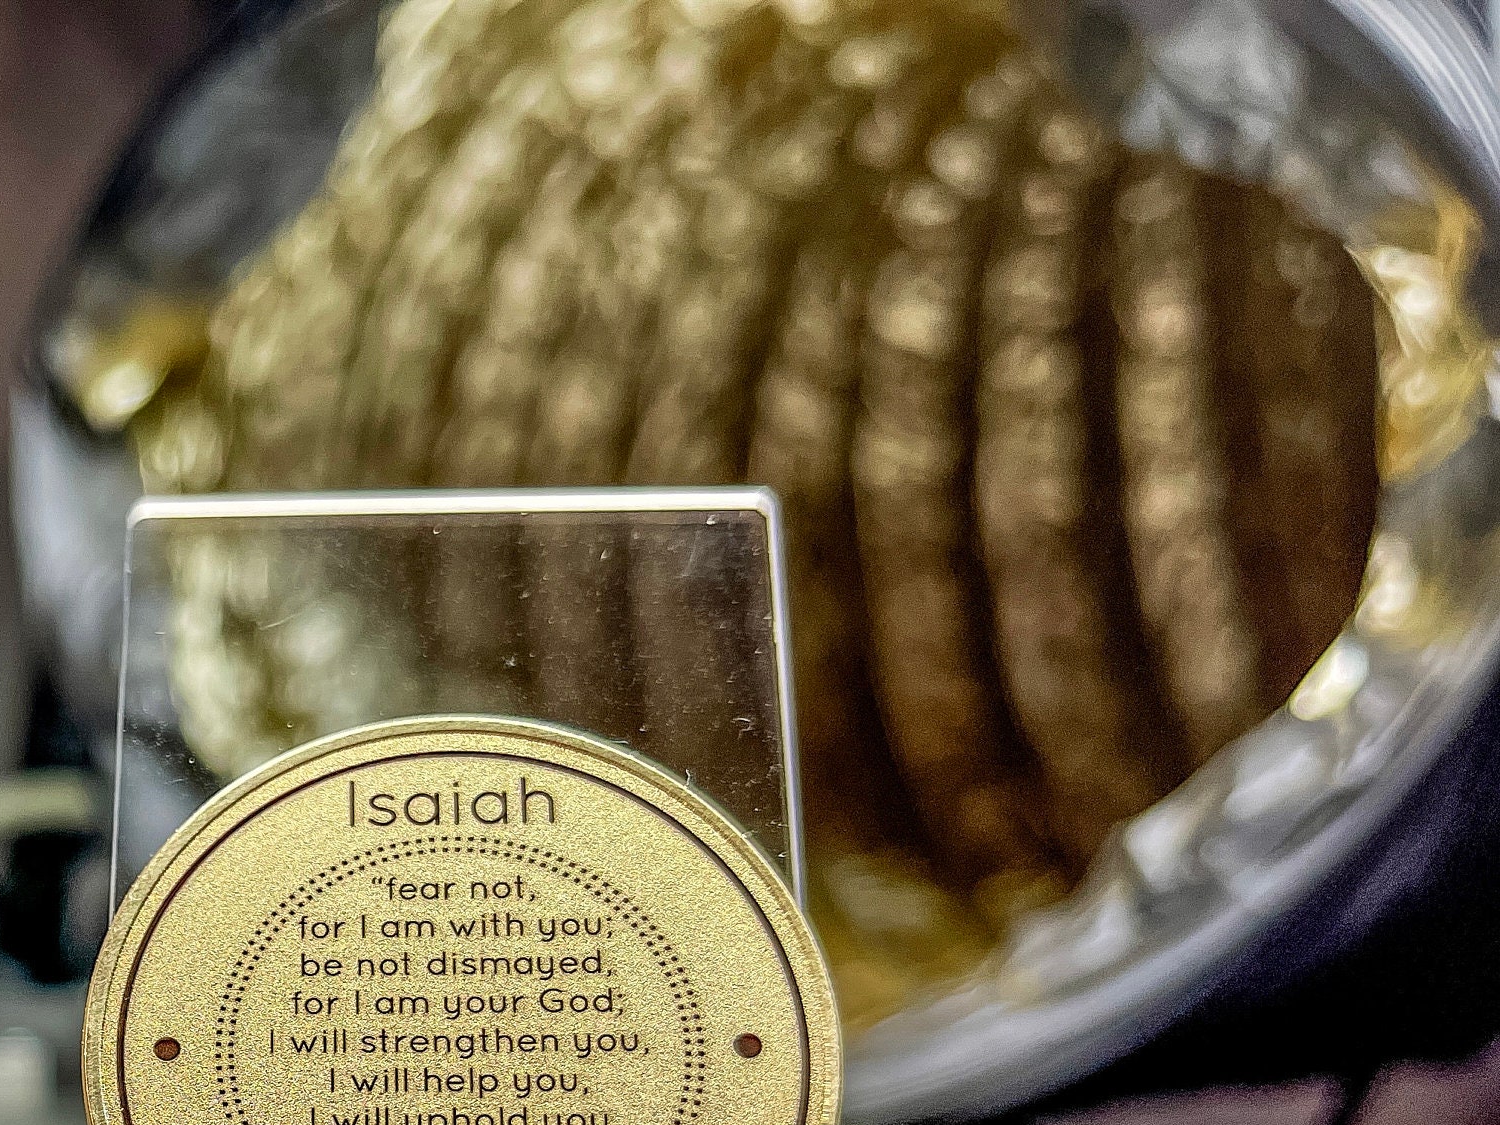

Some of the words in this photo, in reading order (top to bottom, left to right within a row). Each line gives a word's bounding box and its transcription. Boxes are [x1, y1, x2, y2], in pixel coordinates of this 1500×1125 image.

[348, 777, 558, 828] Isaiah
[371, 877, 456, 900] “fear
[470, 875, 536, 901] not,
[300, 916, 345, 938] for
[381, 919, 434, 938] am
[450, 914, 524, 937] with
[538, 917, 612, 942] you;
[301, 953, 342, 977] be
[358, 952, 411, 976] not
[427, 951, 612, 980] dismayed,
[291, 992, 339, 1015] for
[375, 995, 429, 1014] am
[442, 994, 523, 1019] your
[539, 988, 624, 1016] God;
[291, 1029, 346, 1052] will
[361, 1029, 559, 1059] strengthen
[573, 1033, 649, 1060] you,
[351, 1068, 408, 1092] will
[424, 1067, 499, 1098] help
[512, 1072, 588, 1098] you,
